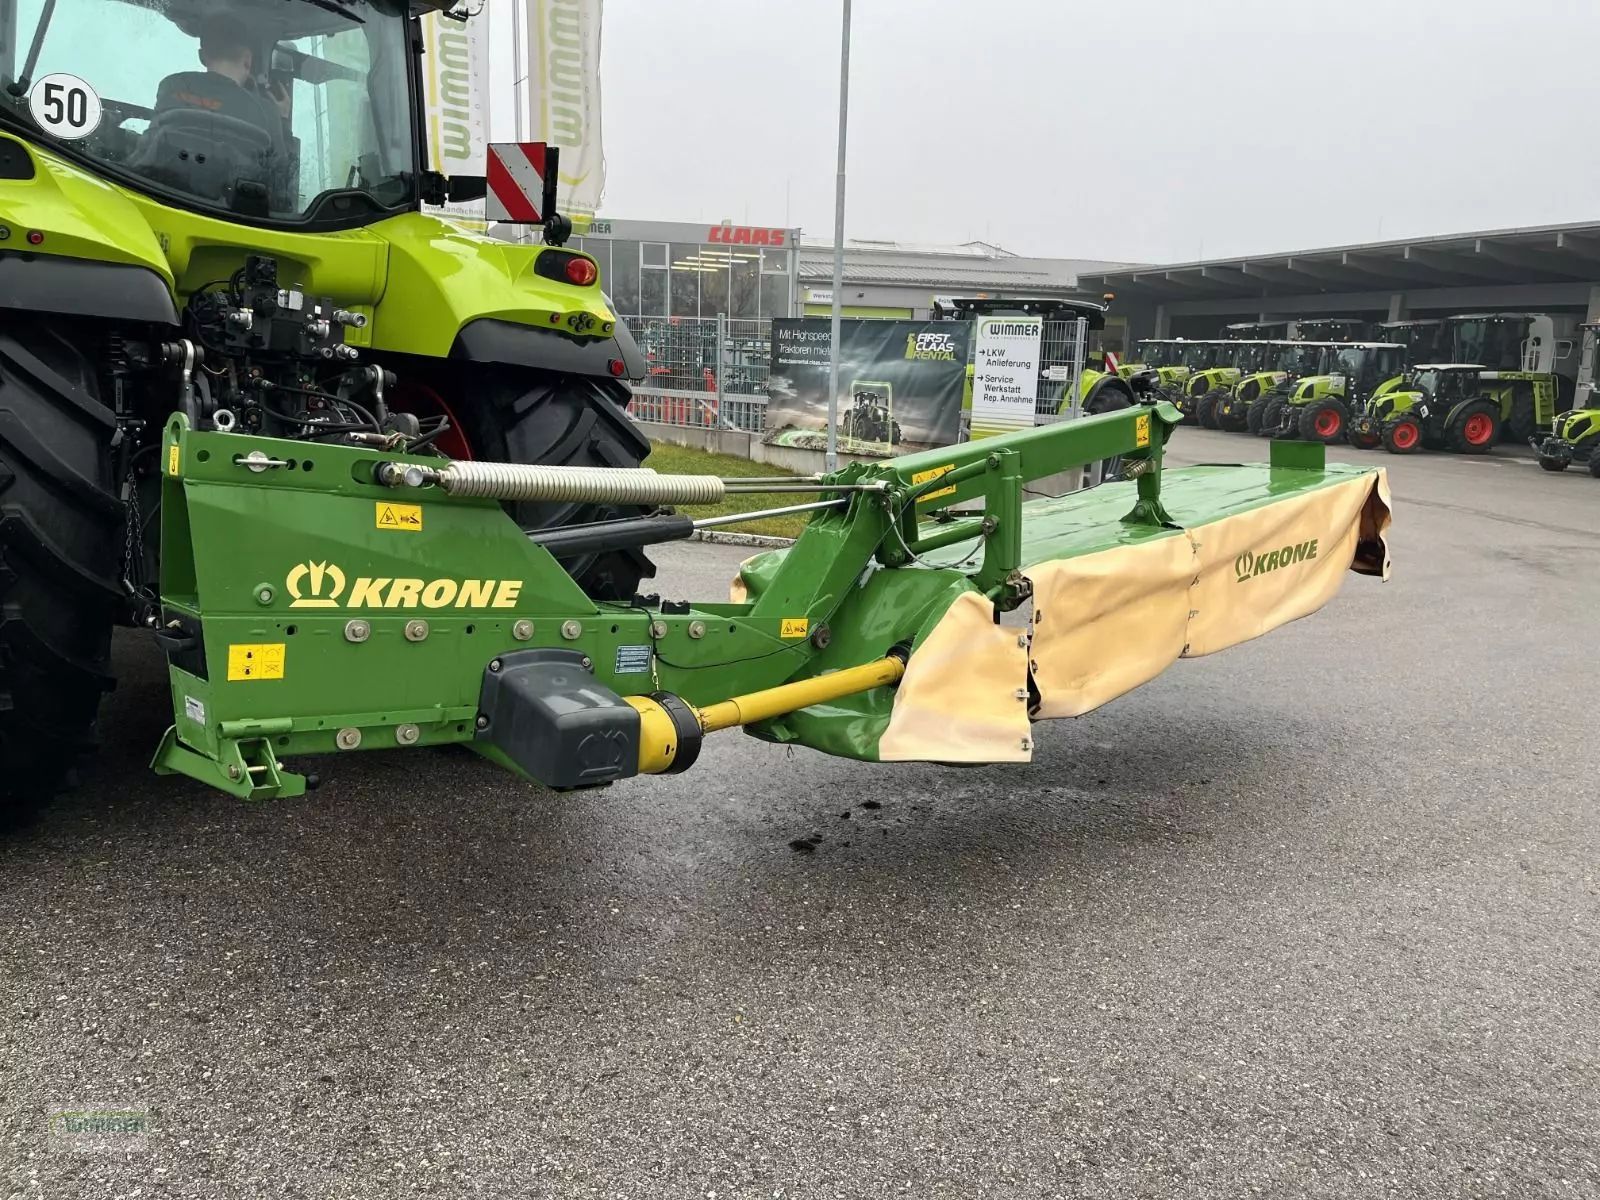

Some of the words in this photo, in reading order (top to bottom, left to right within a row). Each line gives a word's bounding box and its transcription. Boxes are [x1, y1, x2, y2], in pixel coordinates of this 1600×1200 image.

[44, 83, 87, 128] 50
[589, 222, 612, 234] MER
[708, 225, 785, 247] CLAAS
[779, 329, 791, 340] Mit
[990, 323, 1039, 336] WIMMER
[917, 333, 951, 343] FIRST
[779, 343, 812, 355] Traktoren
[813, 345, 832, 356] miet
[915, 342, 956, 352] CLAAS
[913, 351, 957, 361] RENTAL
[986, 349, 1006, 357] LKW
[986, 358, 1031, 369] Anlieferung
[985, 374, 1014, 383] Service
[984, 384, 1021, 394] Werkstatt
[983, 393, 999, 403] Rep.
[1000, 394, 1033, 404] Annahme
[1253, 539, 1318, 576] KRONE
[347, 577, 523, 608] KRONE
